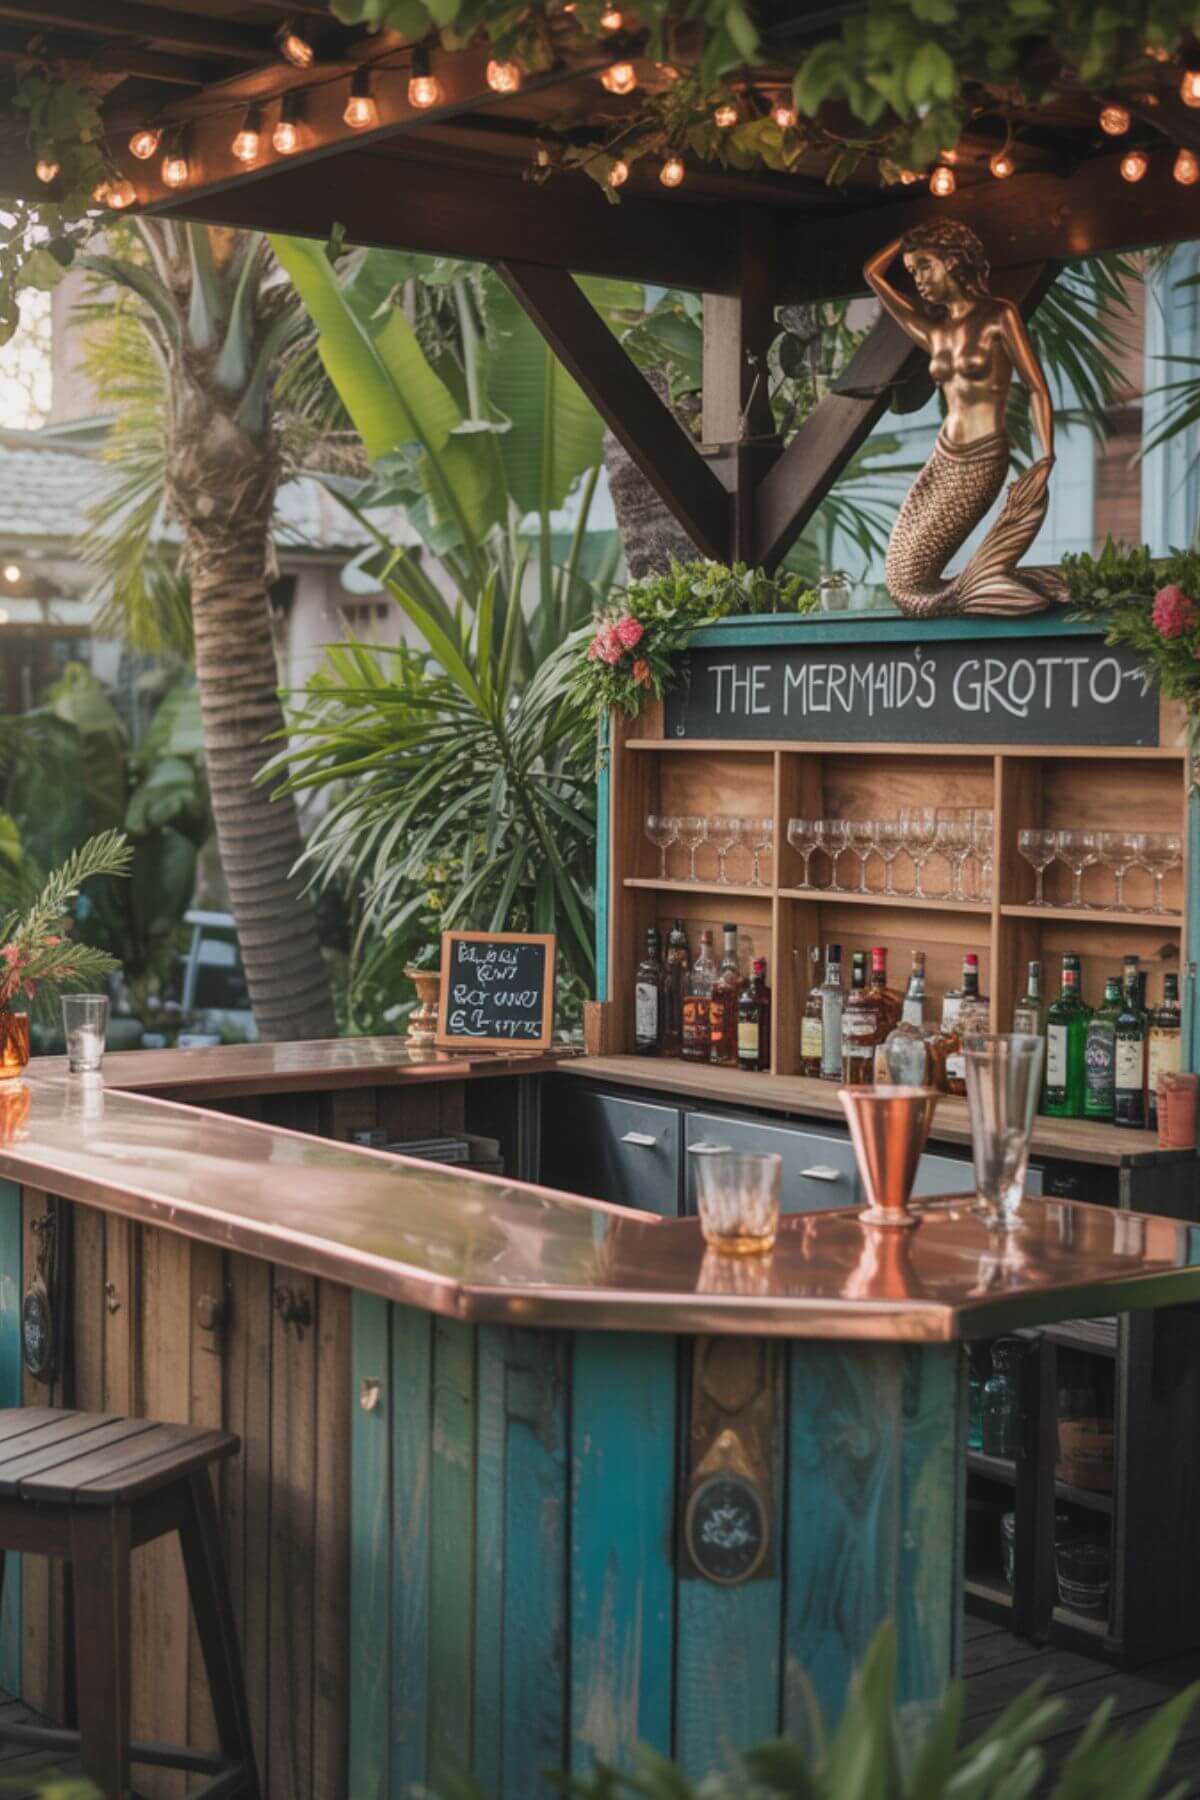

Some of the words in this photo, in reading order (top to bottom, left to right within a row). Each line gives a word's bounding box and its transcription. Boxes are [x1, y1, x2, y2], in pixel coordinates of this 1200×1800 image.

[707, 663, 772, 715] THE
[783, 648, 937, 717] MERMAID'S
[952, 657, 1122, 718] GROTTO
